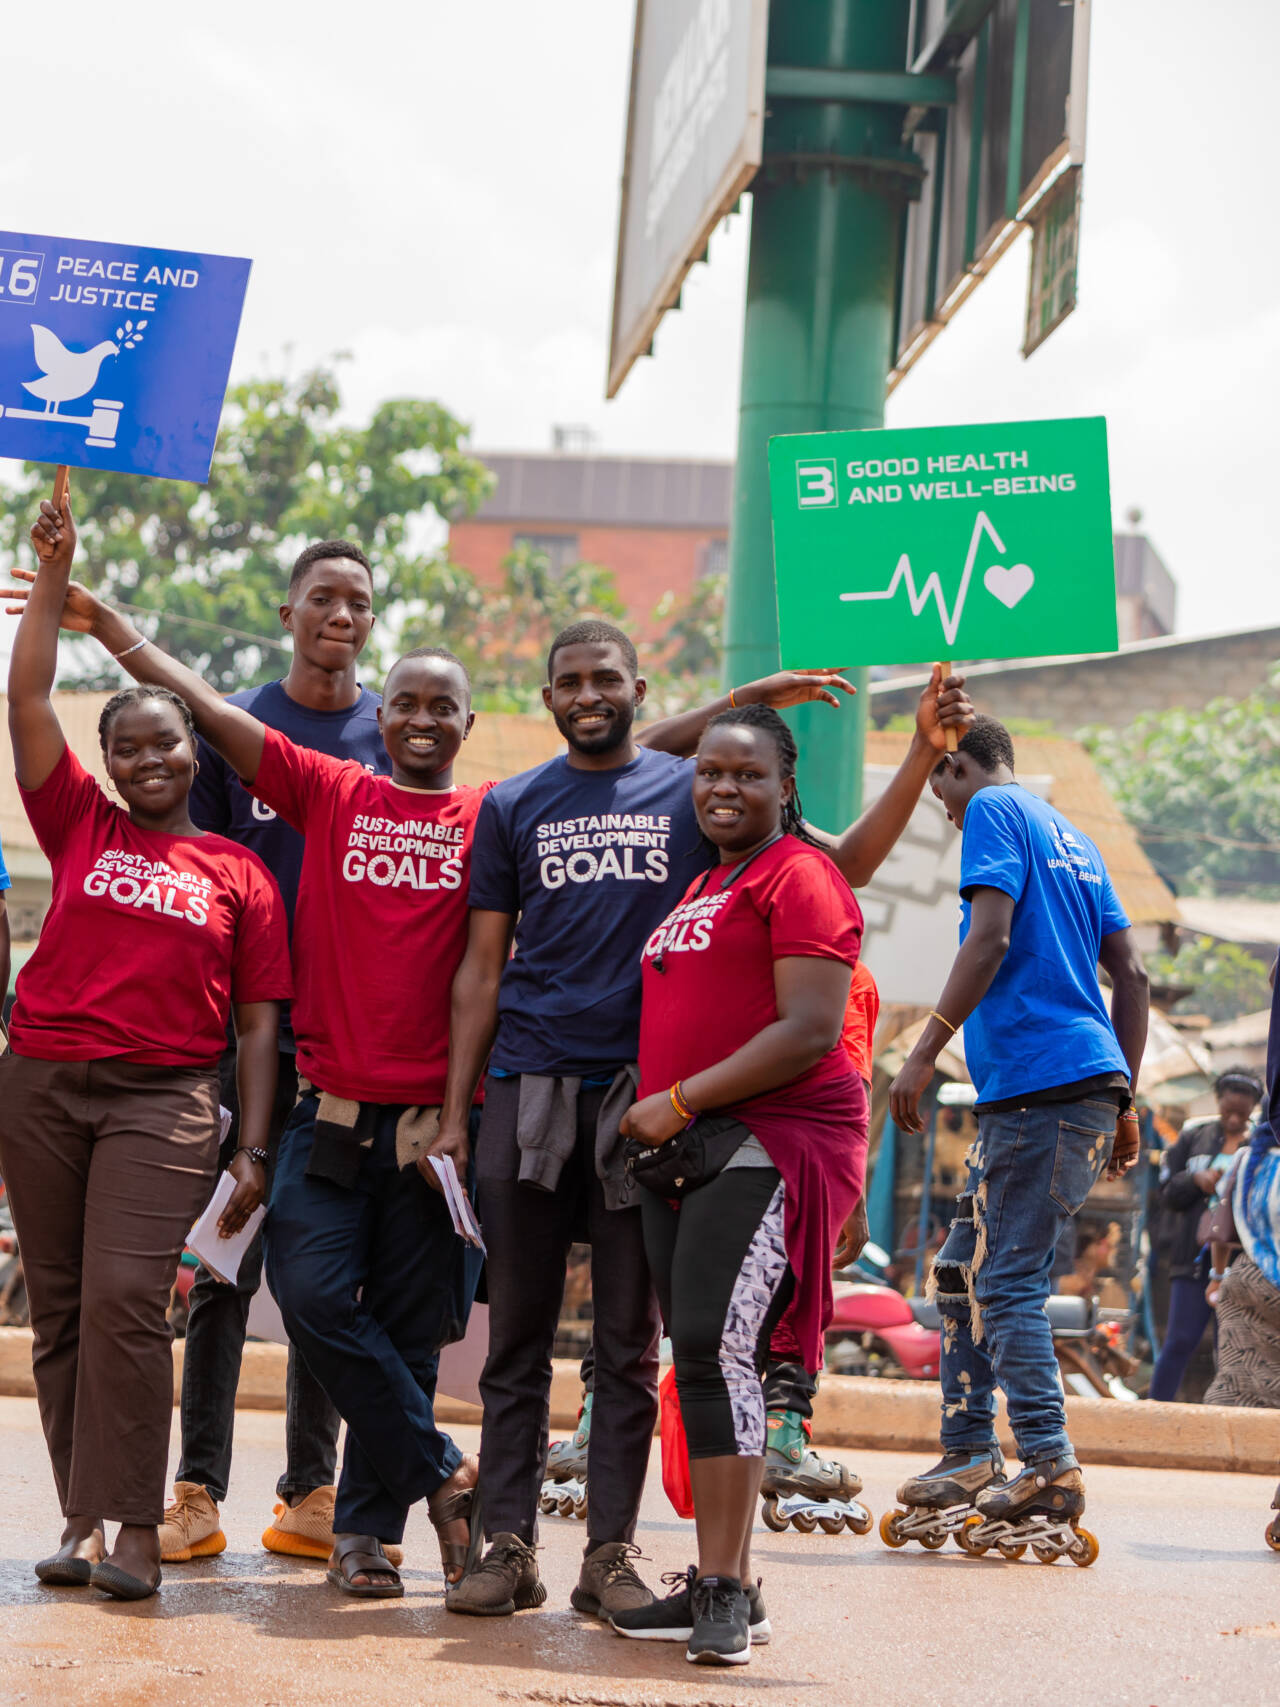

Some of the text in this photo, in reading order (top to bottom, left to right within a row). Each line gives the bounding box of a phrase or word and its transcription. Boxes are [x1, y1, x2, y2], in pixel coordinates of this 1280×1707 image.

[56, 256, 199, 289] PEACE AND
[50, 284, 158, 312] JUSTICE
[846, 451, 1028, 479] GOOD HEALTH
[799, 466, 835, 506] 3
[848, 473, 1076, 505] AND WELL-BEING
[353, 814, 465, 844] SUSTAINABLE
[536, 814, 671, 839] SUSTAINABLE
[347, 832, 465, 859] DEVELOPMENT
[537, 831, 670, 857] DEVELOPMENT
[93, 858, 211, 899] DEVELOPMENT
[101, 848, 213, 891] SUSTAINABLE
[342, 849, 463, 890] GOALS
[540, 847, 670, 890] GOALS
[83, 870, 210, 927] GOALS
[644, 918, 714, 957] OALS
